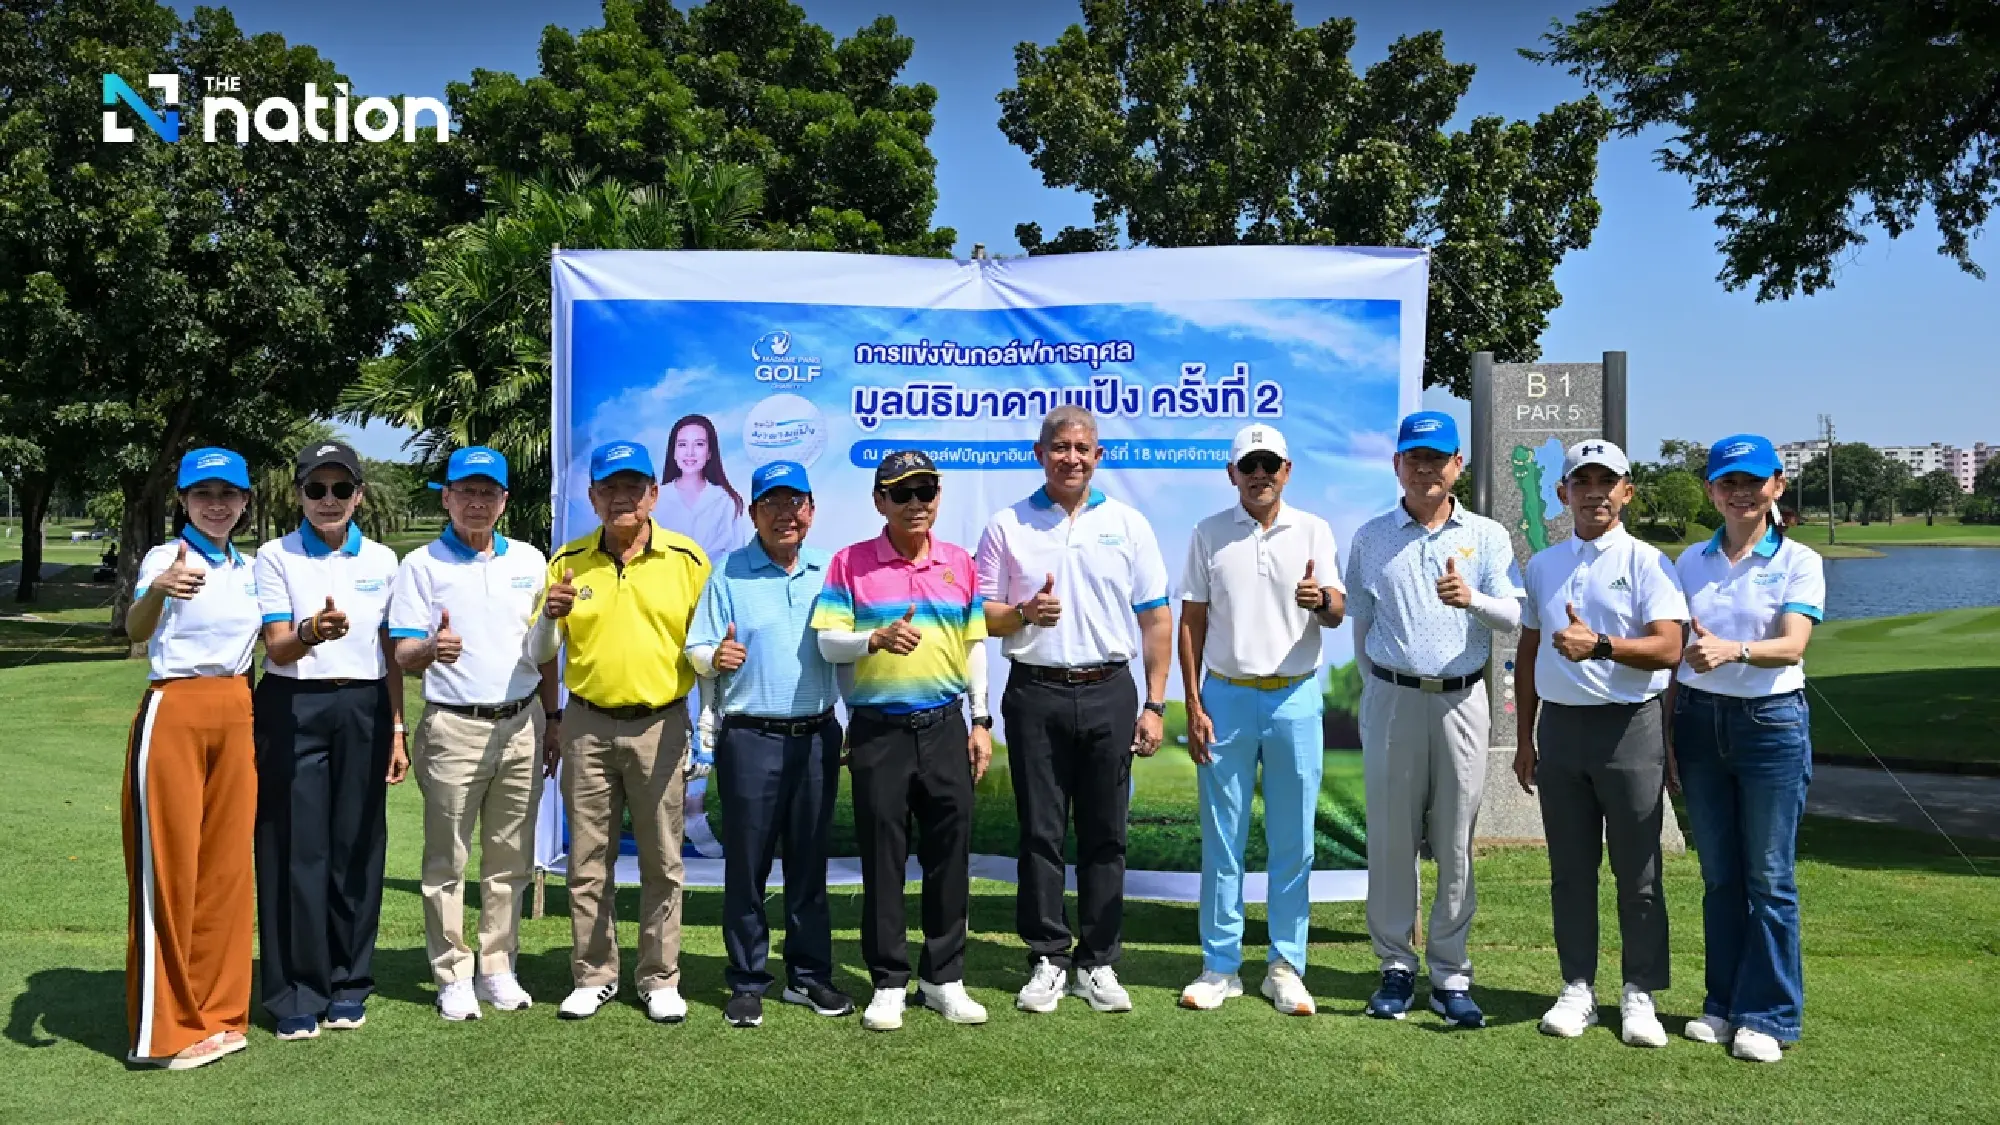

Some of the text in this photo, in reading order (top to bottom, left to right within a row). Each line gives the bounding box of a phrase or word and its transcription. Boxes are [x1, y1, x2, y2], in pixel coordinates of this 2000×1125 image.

[855, 340, 1134, 368] การแข่งขันกอล์ฟการกุศล
[755, 364, 821, 382] GOLF
[1150, 363, 1248, 416] ครั้งที่
[1254, 381, 1282, 416] 2
[1527, 371, 1570, 398] B 1
[1516, 404, 1580, 421] PAR 5
[862, 448, 878, 460] ณ
[1133, 447, 1152, 461] 18
